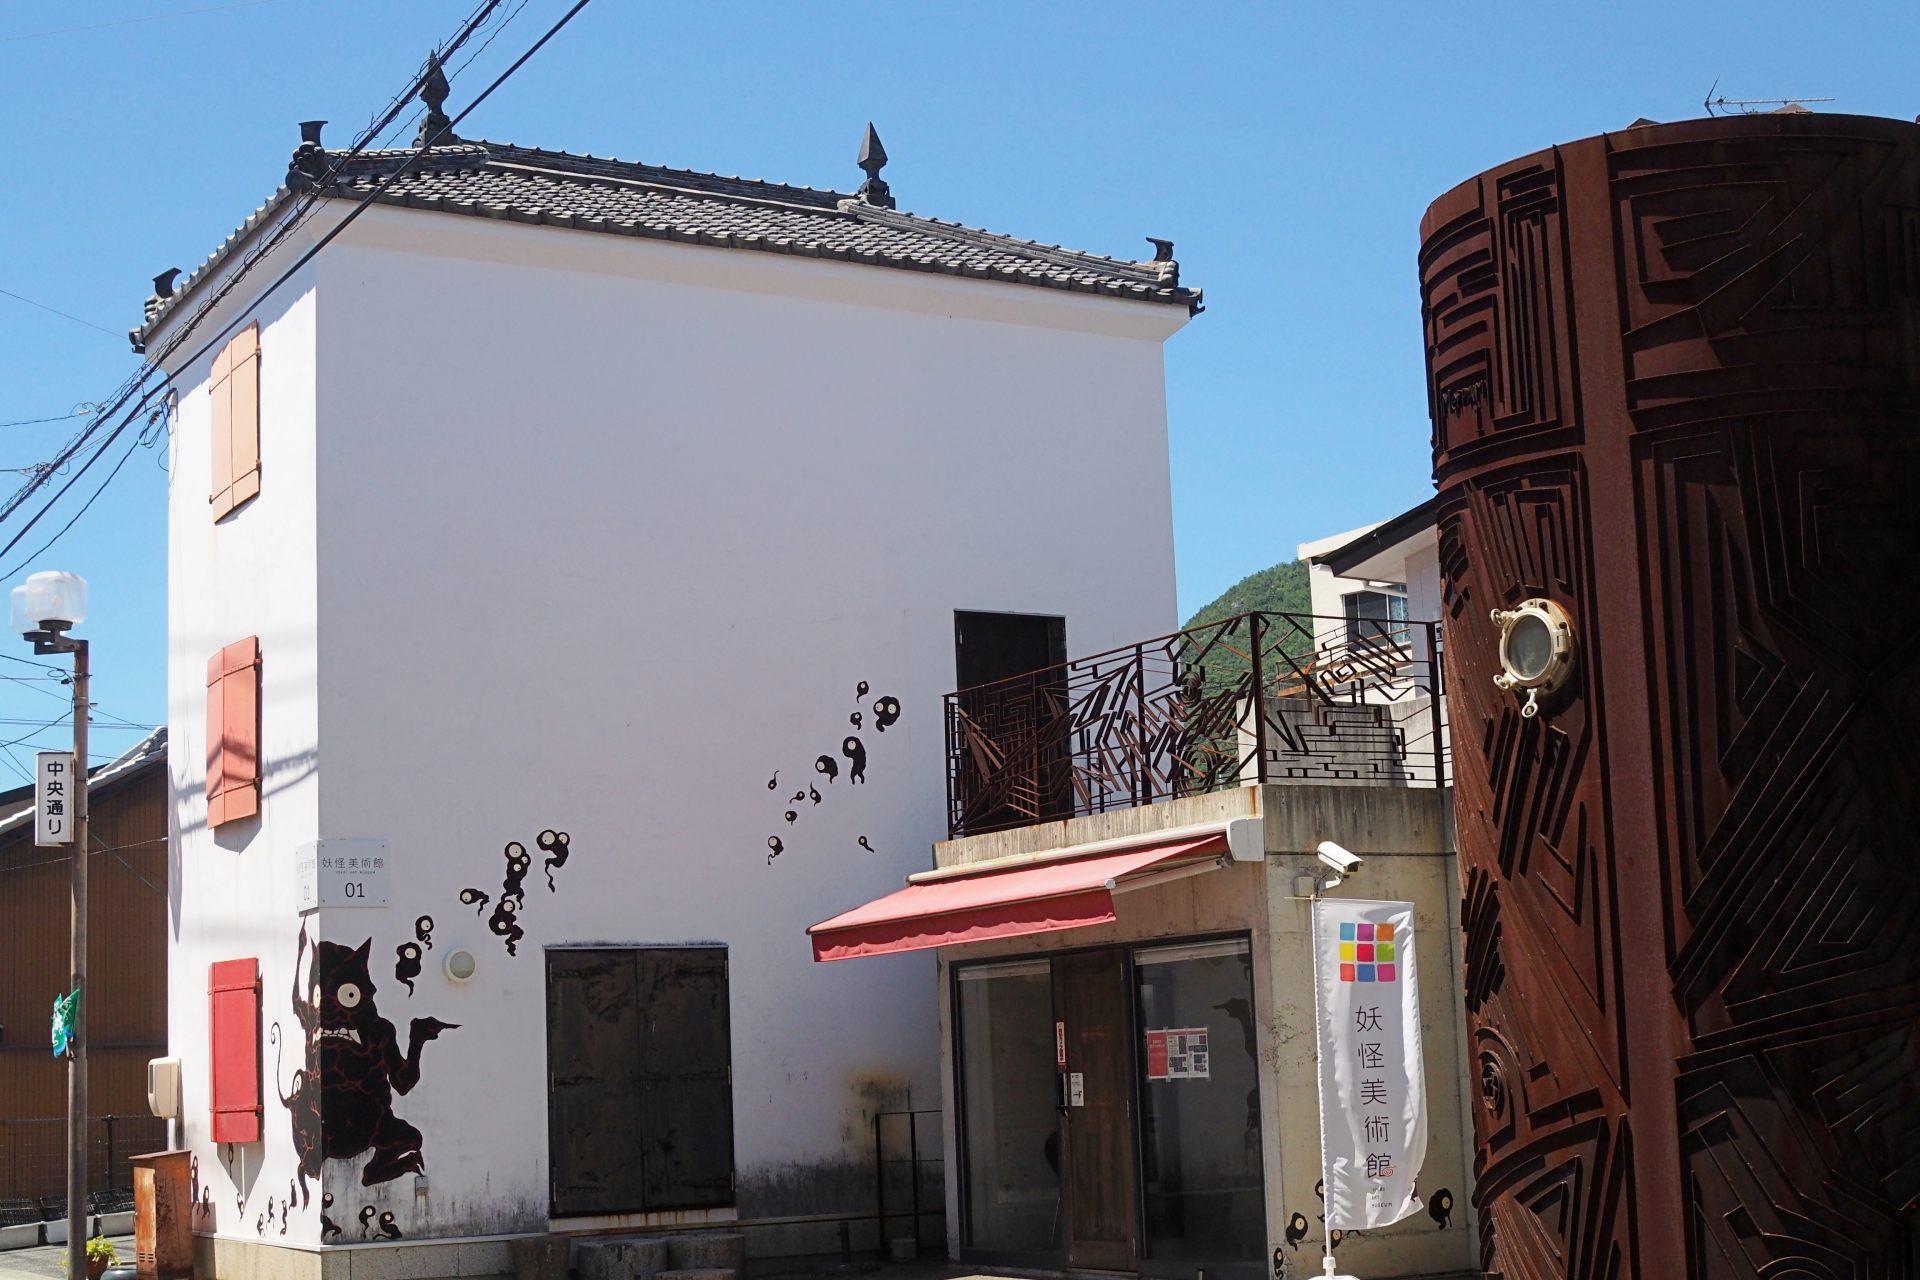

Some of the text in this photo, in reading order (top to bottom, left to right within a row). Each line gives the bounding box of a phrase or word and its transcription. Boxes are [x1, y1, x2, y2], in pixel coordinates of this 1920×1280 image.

[46, 761, 64, 835] 中央通り
[322, 857, 384, 869] 妖怪美術館
[345, 882, 365, 898] 01
[1355, 1005, 1392, 1178] 妖怪美術館
